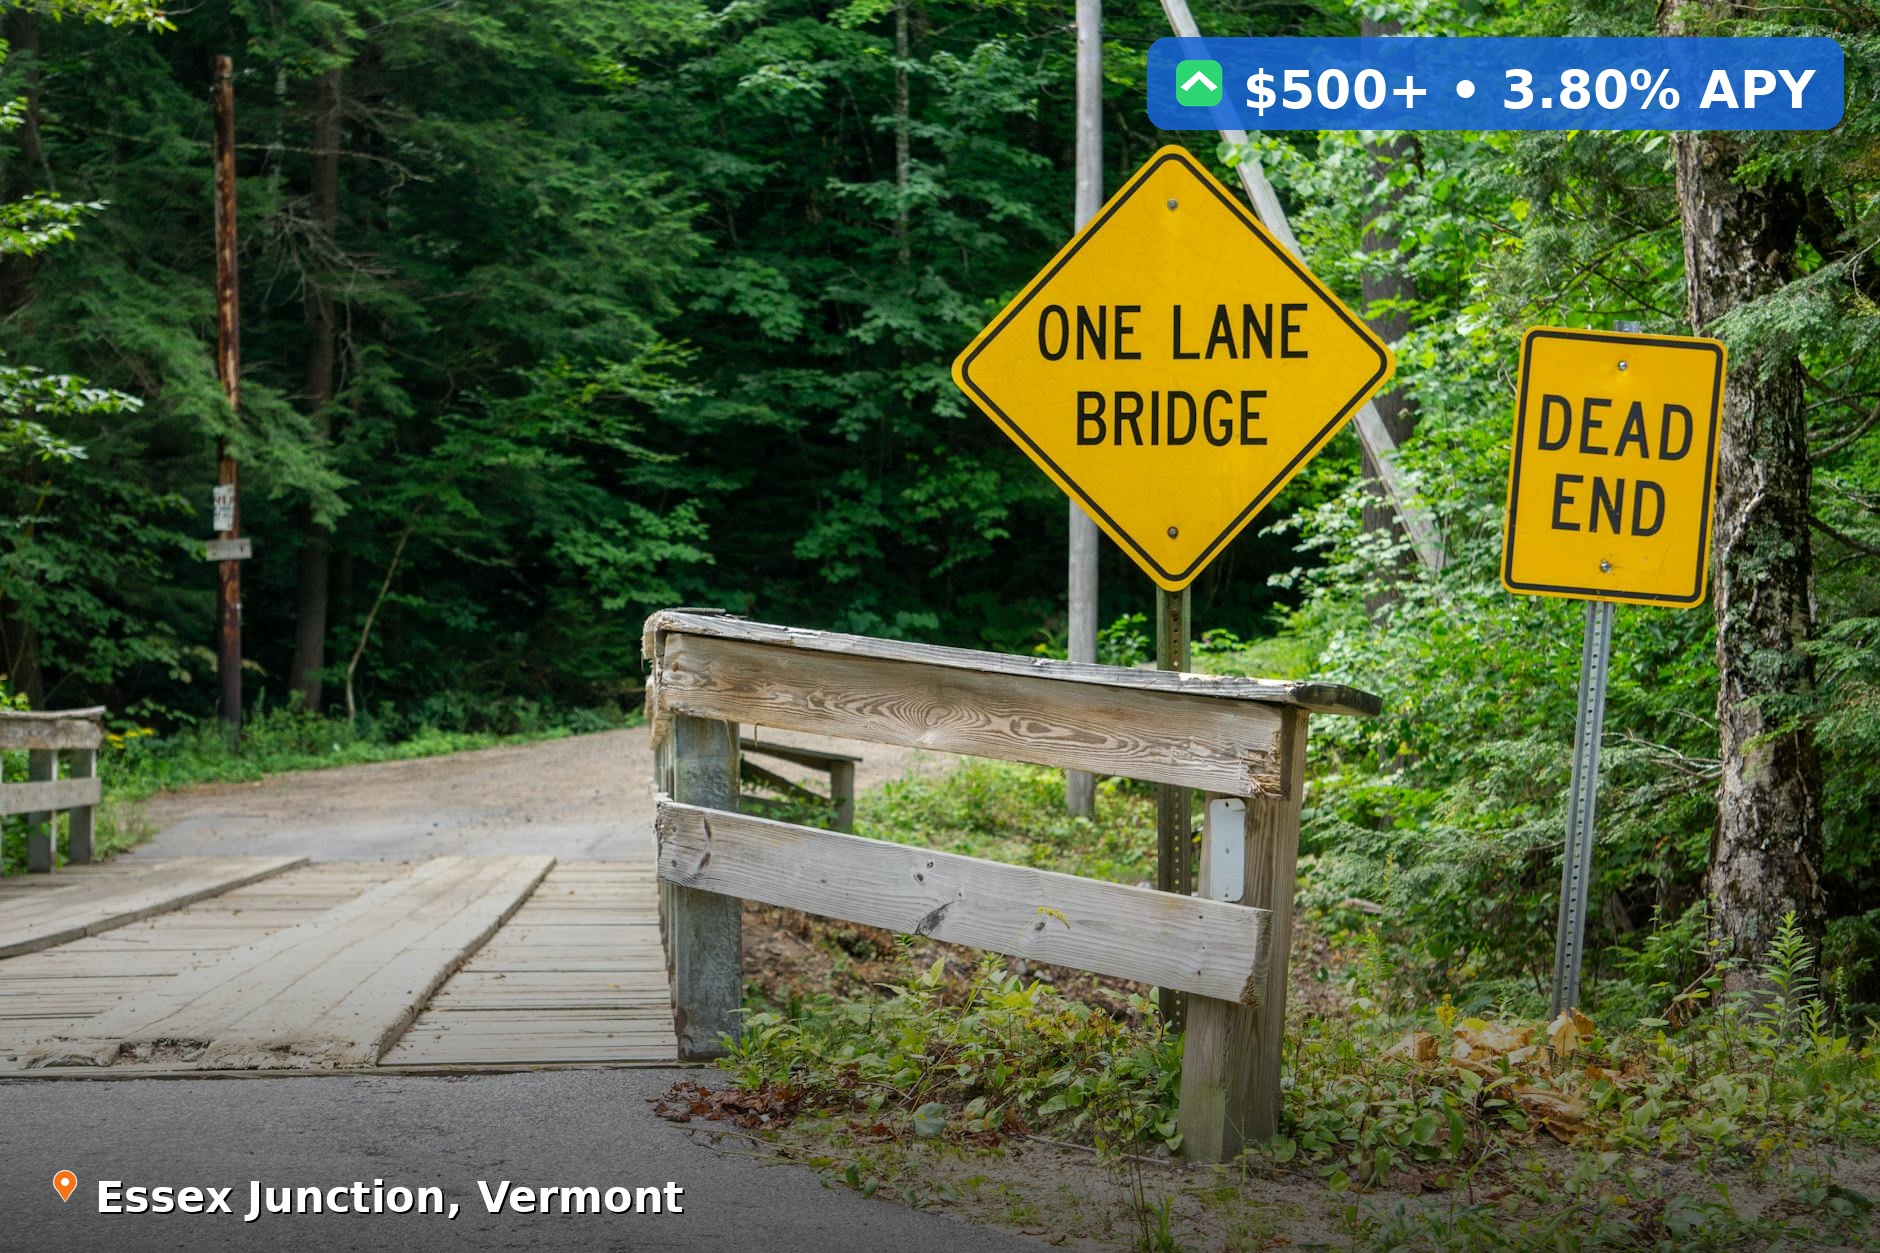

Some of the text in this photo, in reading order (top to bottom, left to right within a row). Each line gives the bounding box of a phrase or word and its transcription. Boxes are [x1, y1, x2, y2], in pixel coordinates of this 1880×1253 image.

[1038, 303, 1309, 362] ONE LANE
[1076, 389, 1268, 447] BRIDGE
[1537, 393, 1694, 461] DEAD
[1551, 473, 1666, 537] END
